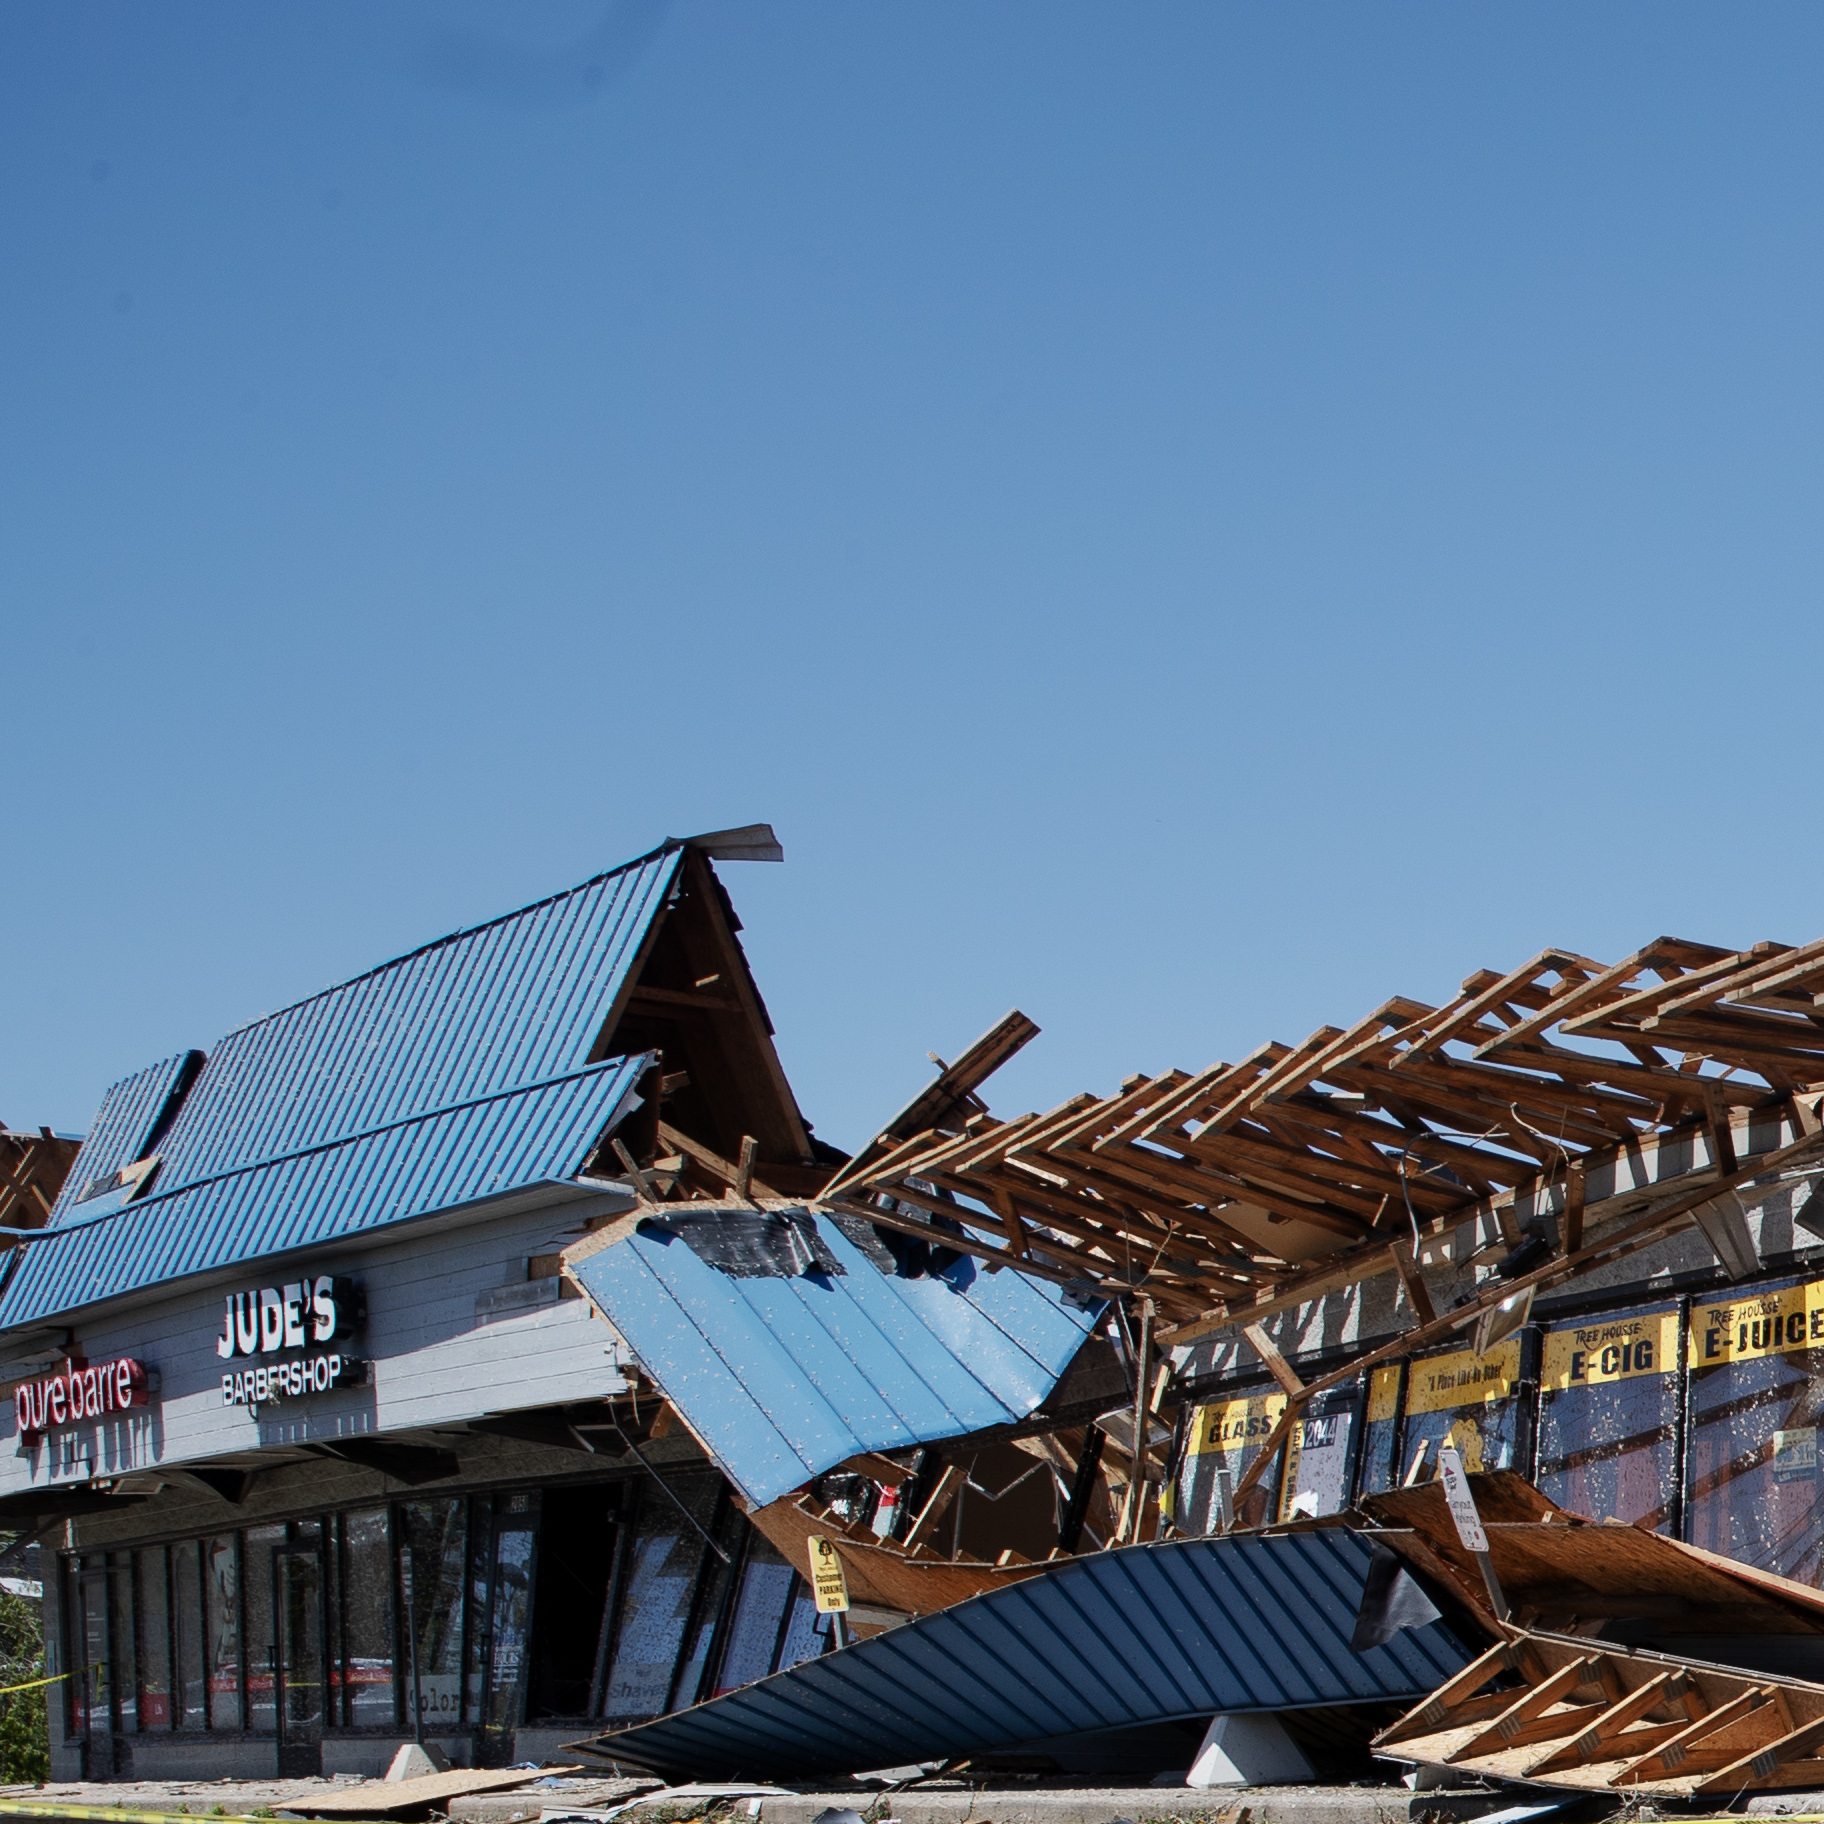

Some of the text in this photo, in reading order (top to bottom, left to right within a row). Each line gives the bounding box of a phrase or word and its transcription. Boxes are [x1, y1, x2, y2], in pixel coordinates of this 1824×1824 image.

[216, 1276, 336, 1359] JUDE'S
[1707, 1301, 1780, 1331] TREE HOUSSE
[1573, 1323, 1642, 1350] TREE HOUSSE
[1571, 1340, 1653, 1380] E-CIG
[15, 1357, 132, 1431] pure barre
[221, 1355, 341, 1406] BARBERSHOP
[1208, 1414, 1273, 1444] GLASS
[1305, 1420, 1337, 1449] 2044
